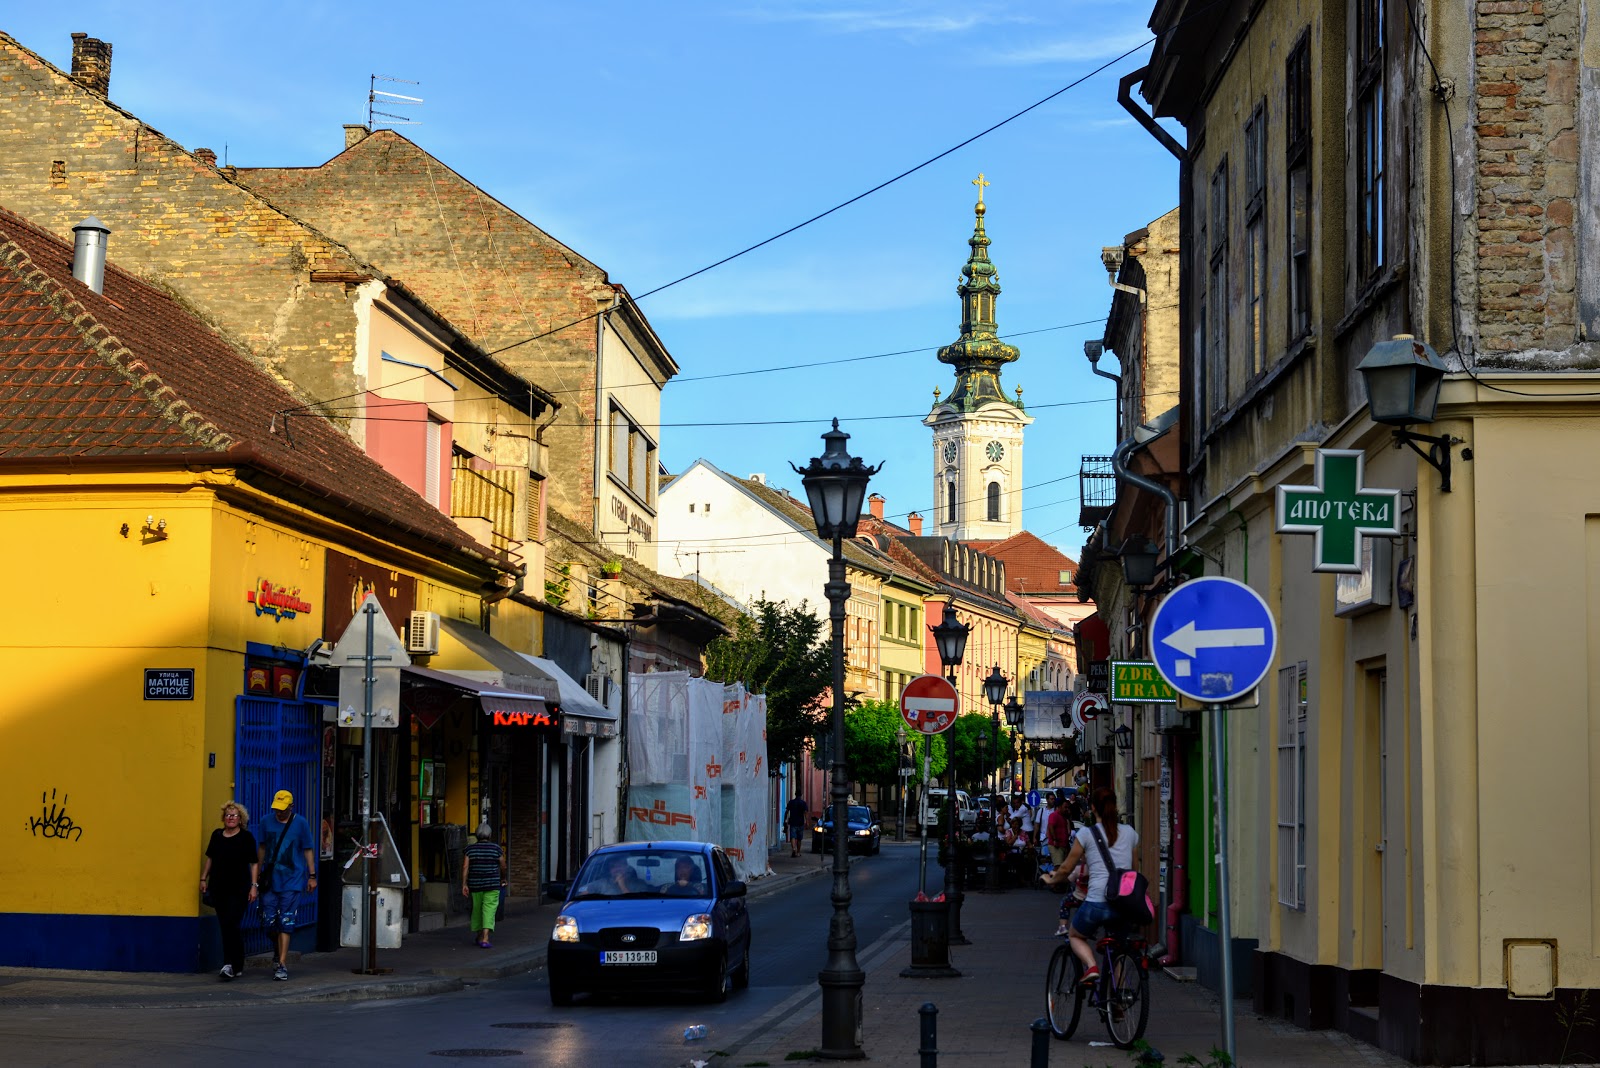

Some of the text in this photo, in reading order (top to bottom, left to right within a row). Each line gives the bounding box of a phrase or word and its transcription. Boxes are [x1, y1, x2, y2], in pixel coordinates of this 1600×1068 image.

[1290, 499, 1388, 521] АПОТЕКА
[148, 678, 190, 687] МАТИЦЕ
[149, 686, 189, 695] СРПСКЕ
[1043, 753, 1068, 763] FONTANA
[606, 952, 618, 962] NS
